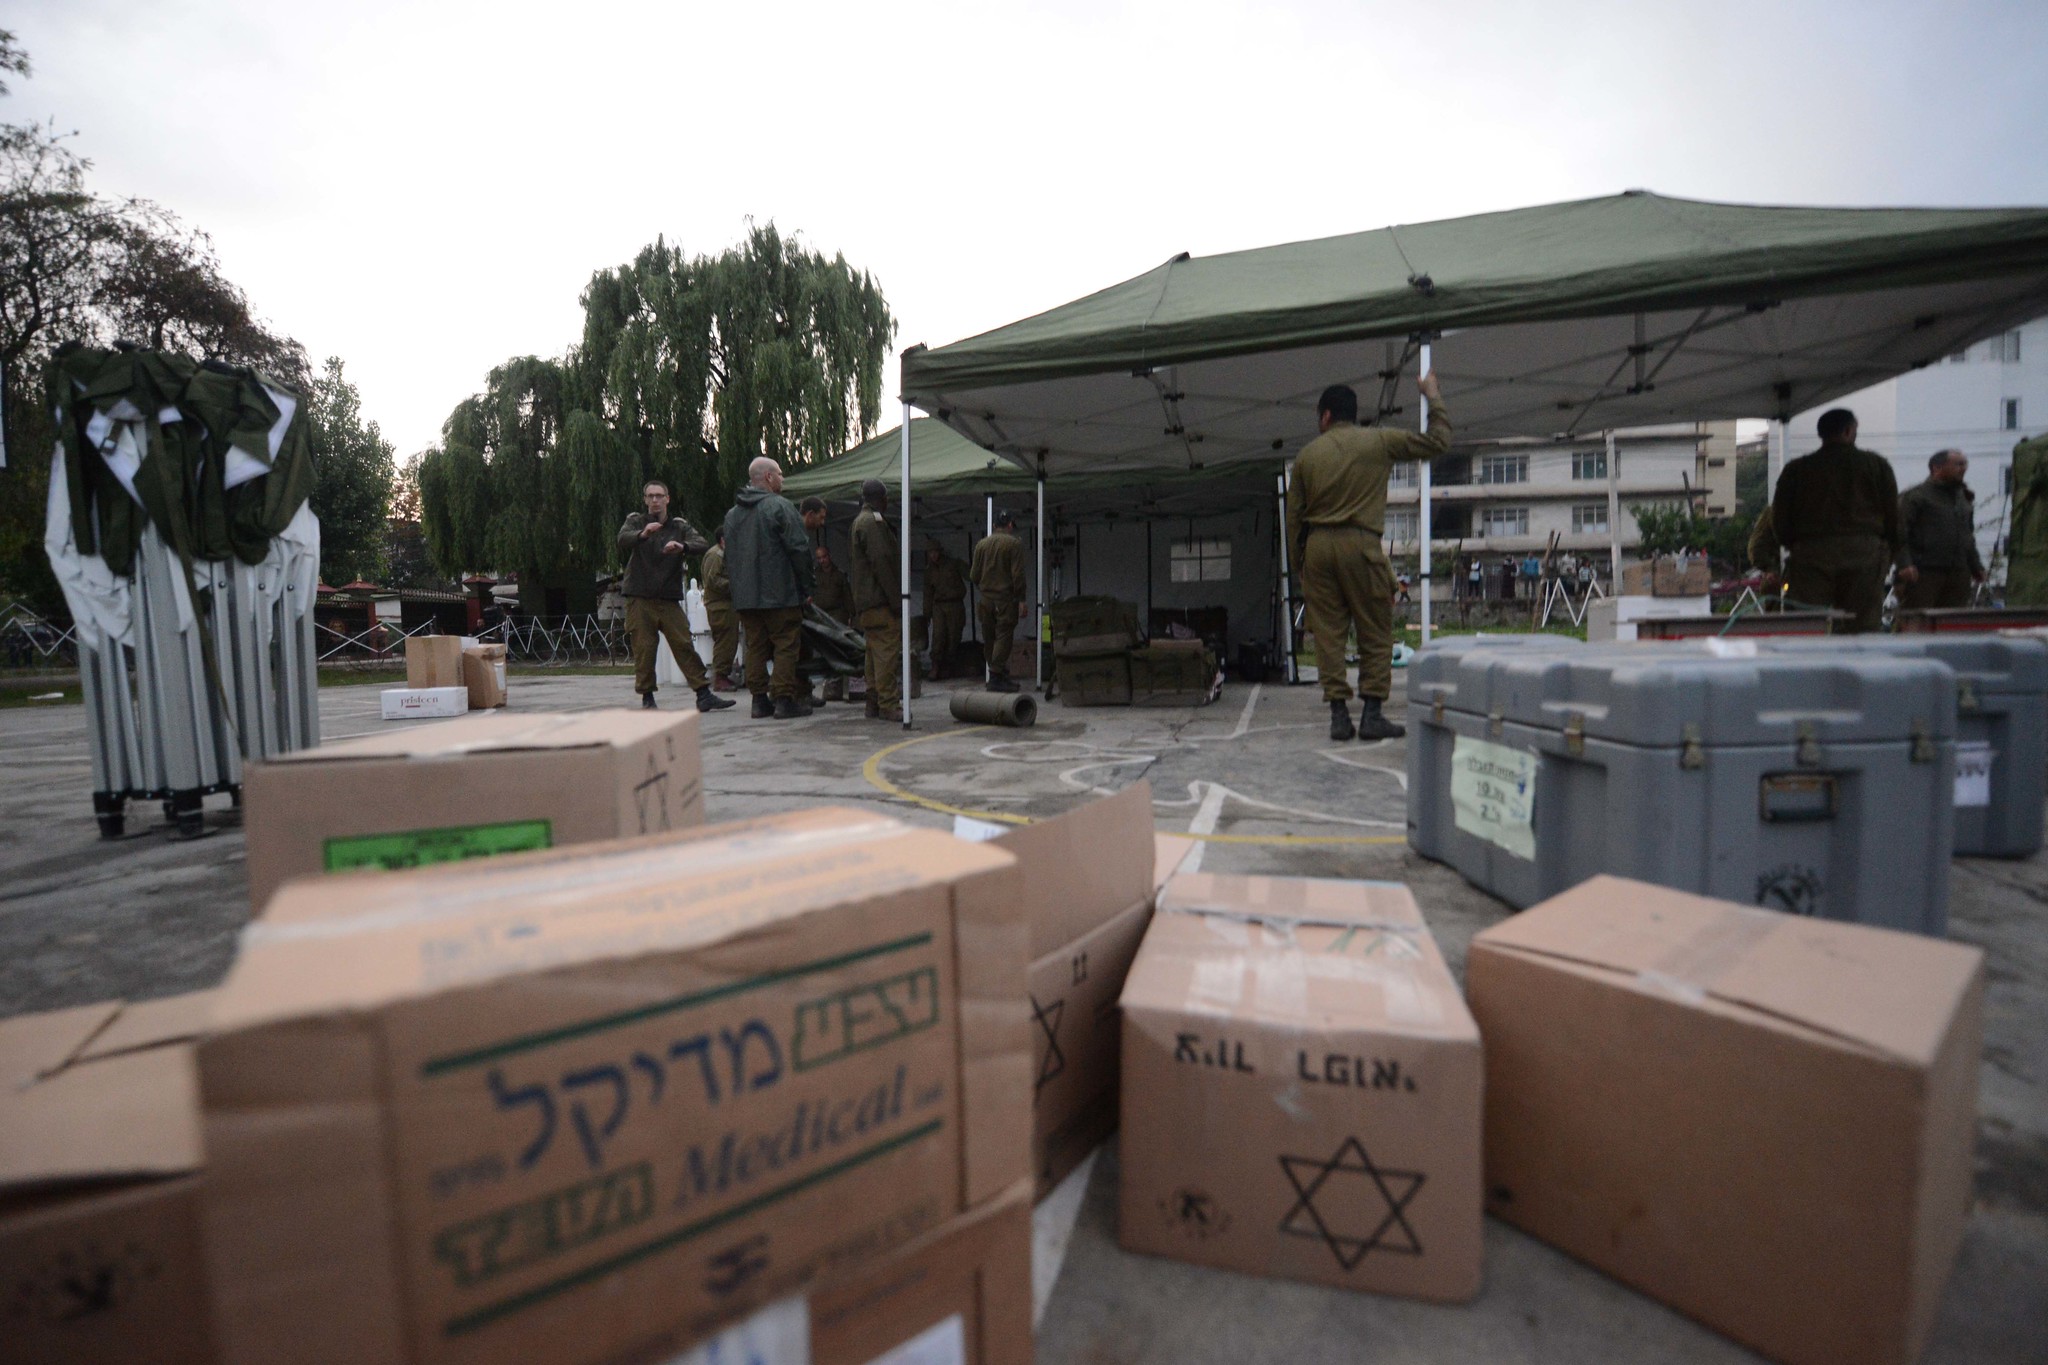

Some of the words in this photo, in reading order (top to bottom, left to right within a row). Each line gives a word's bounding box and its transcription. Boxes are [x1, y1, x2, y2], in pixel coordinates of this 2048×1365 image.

[487, 1015, 785, 1172] מדיקל
[673, 1064, 909, 1209] Medical
[1297, 1048, 1419, 1092] רפואי
